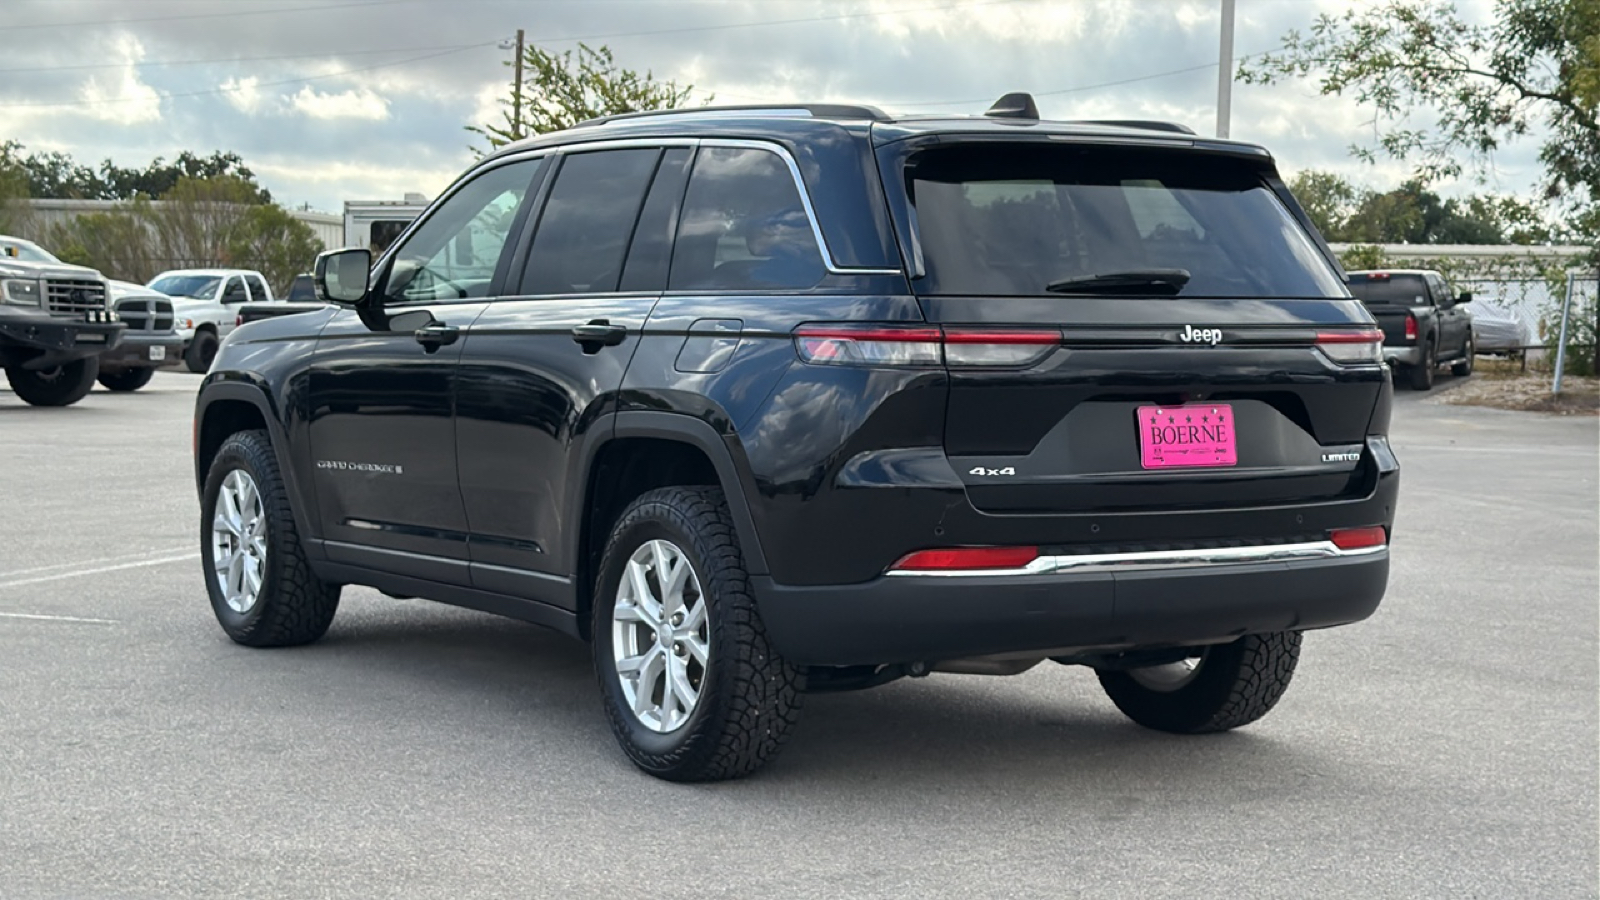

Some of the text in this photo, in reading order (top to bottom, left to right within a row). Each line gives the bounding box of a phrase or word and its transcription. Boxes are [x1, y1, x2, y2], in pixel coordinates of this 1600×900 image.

[1180, 324, 1222, 346] Jeep
[1151, 425, 1227, 445] BOERNE
[1321, 453, 1360, 462] LIMITED
[317, 460, 347, 470] GRAND
[968, 466, 1016, 476] 4x4
